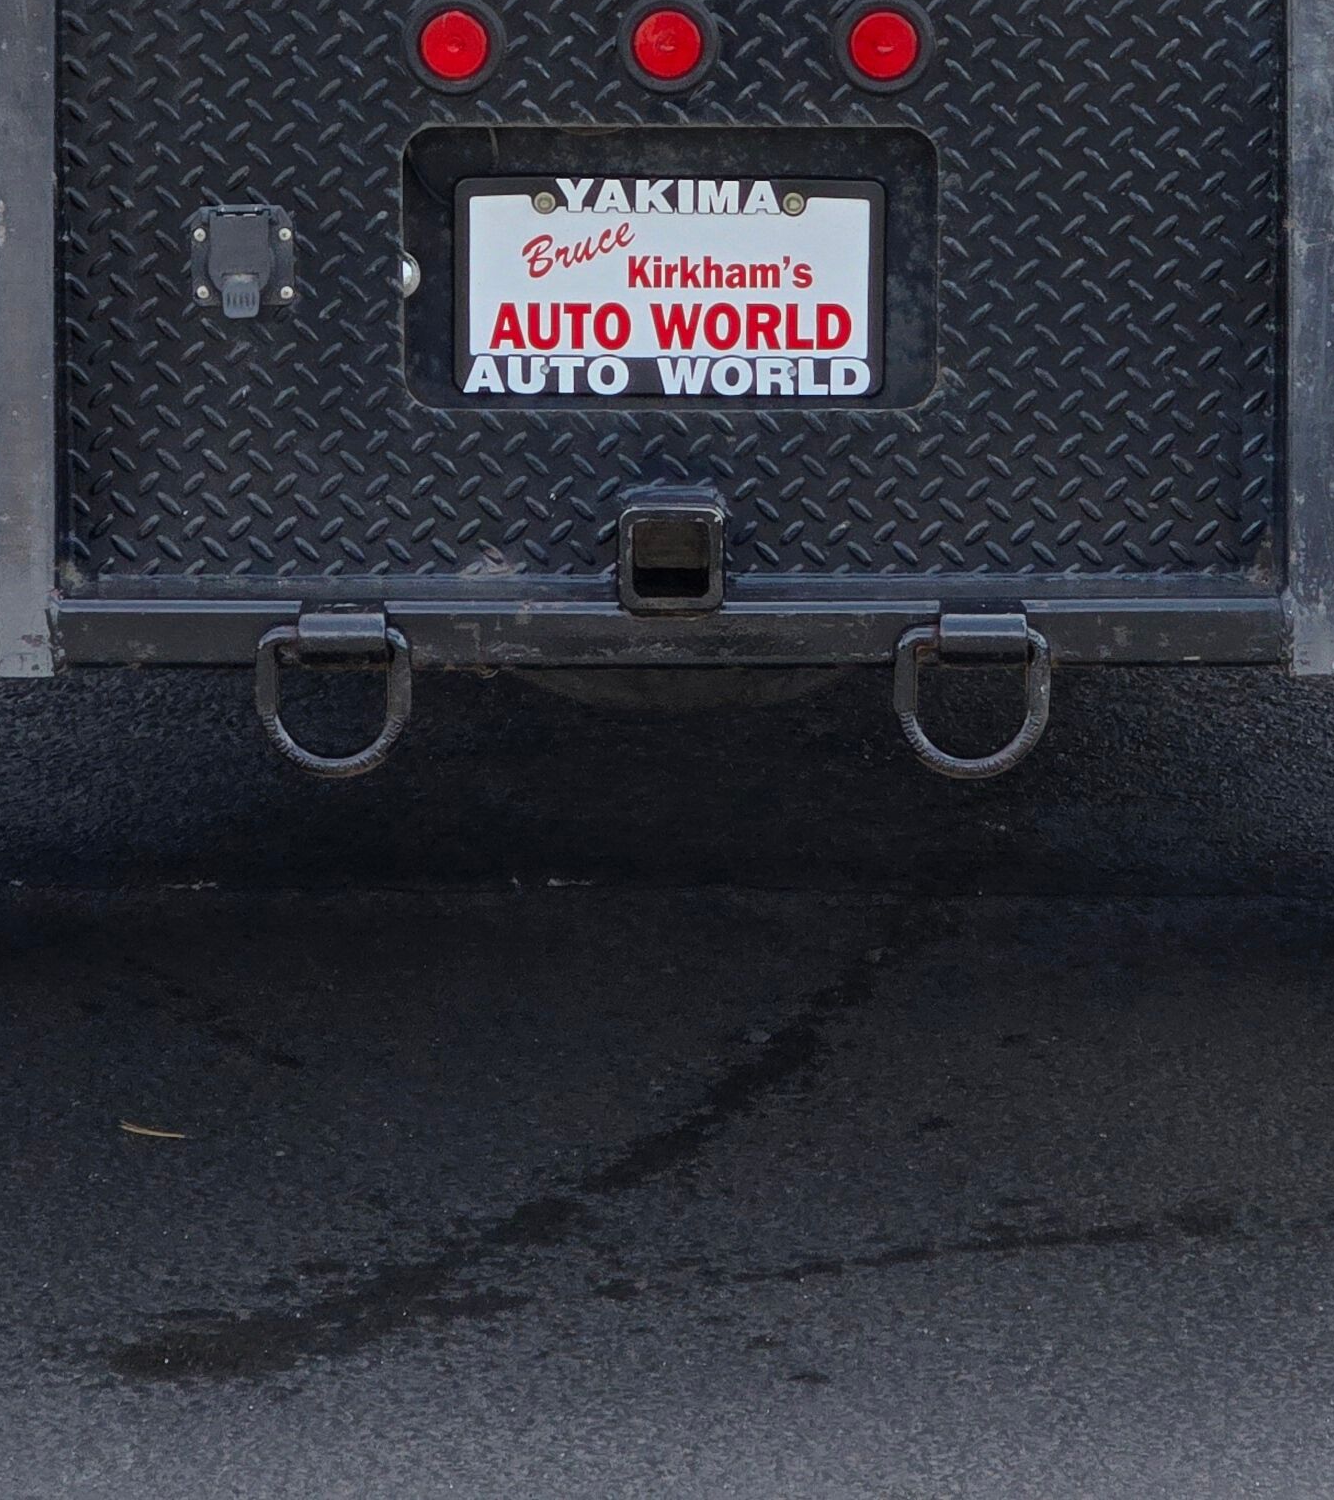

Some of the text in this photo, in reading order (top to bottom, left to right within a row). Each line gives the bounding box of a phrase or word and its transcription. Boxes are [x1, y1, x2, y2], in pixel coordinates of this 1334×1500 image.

[555, 177, 782, 214] YAKIMA
[522, 222, 636, 279] Bruce
[627, 255, 814, 289] Kirkham's
[489, 302, 853, 351] AUTO WORLD
[463, 356, 871, 396] AUTO WORLD
